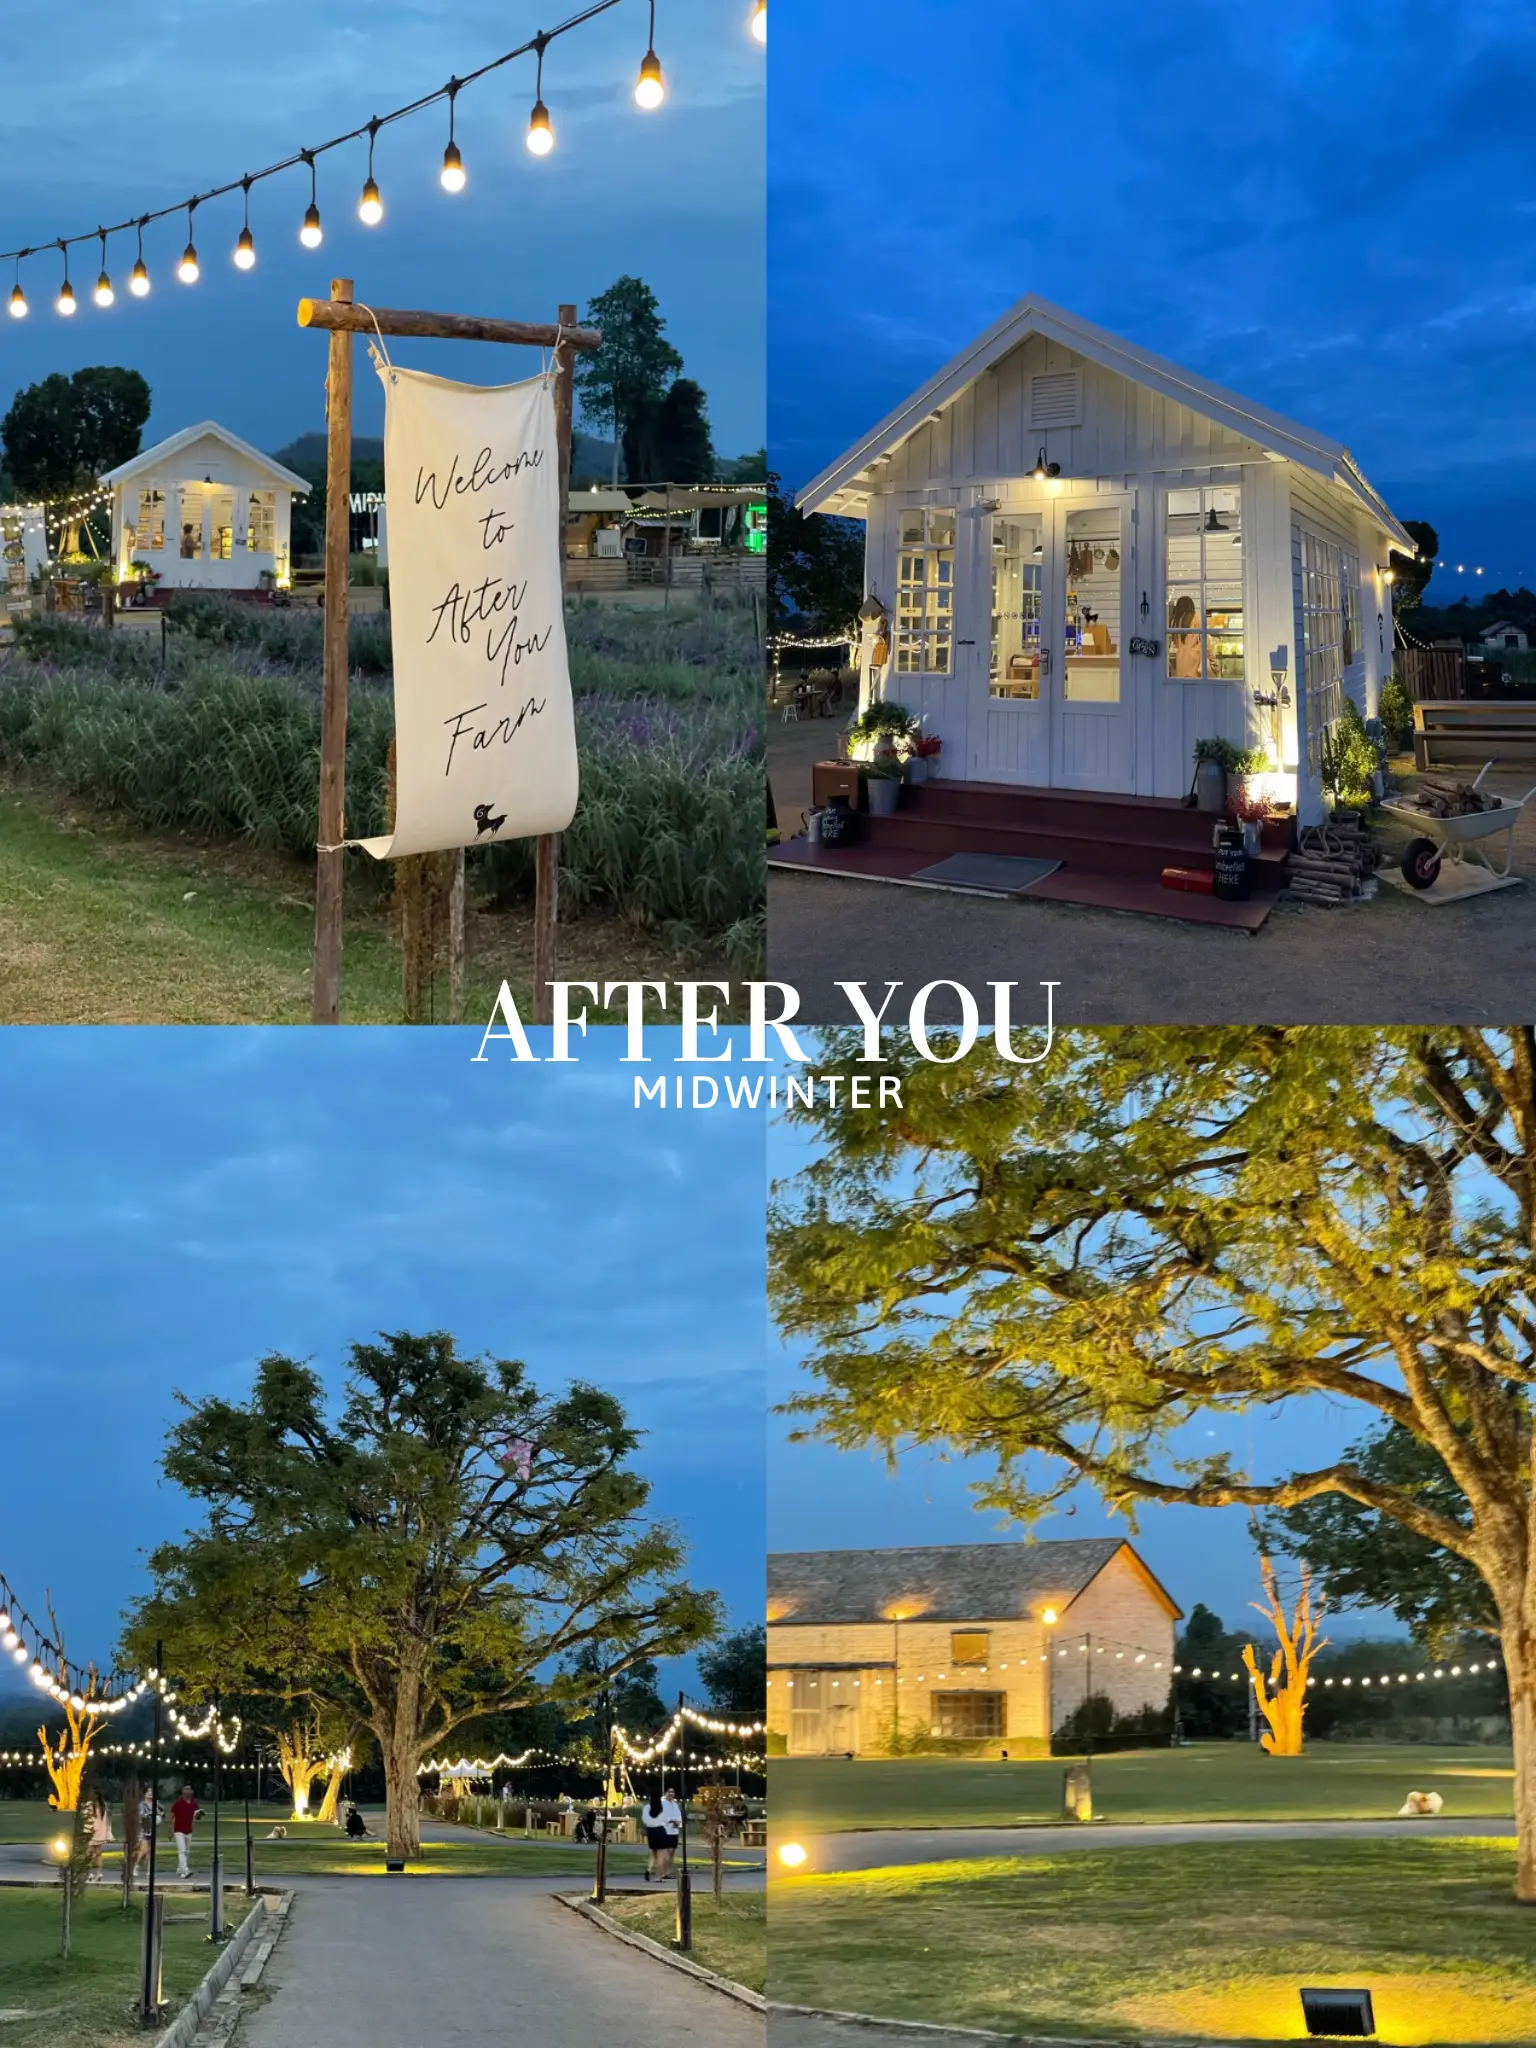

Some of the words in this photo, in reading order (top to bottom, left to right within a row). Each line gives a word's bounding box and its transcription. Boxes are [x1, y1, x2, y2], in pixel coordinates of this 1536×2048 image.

[415, 447, 544, 510] Welcome
[478, 508, 514, 550] to
[426, 577, 527, 644] After
[486, 615, 552, 686] You
[443, 697, 546, 776] Farm
